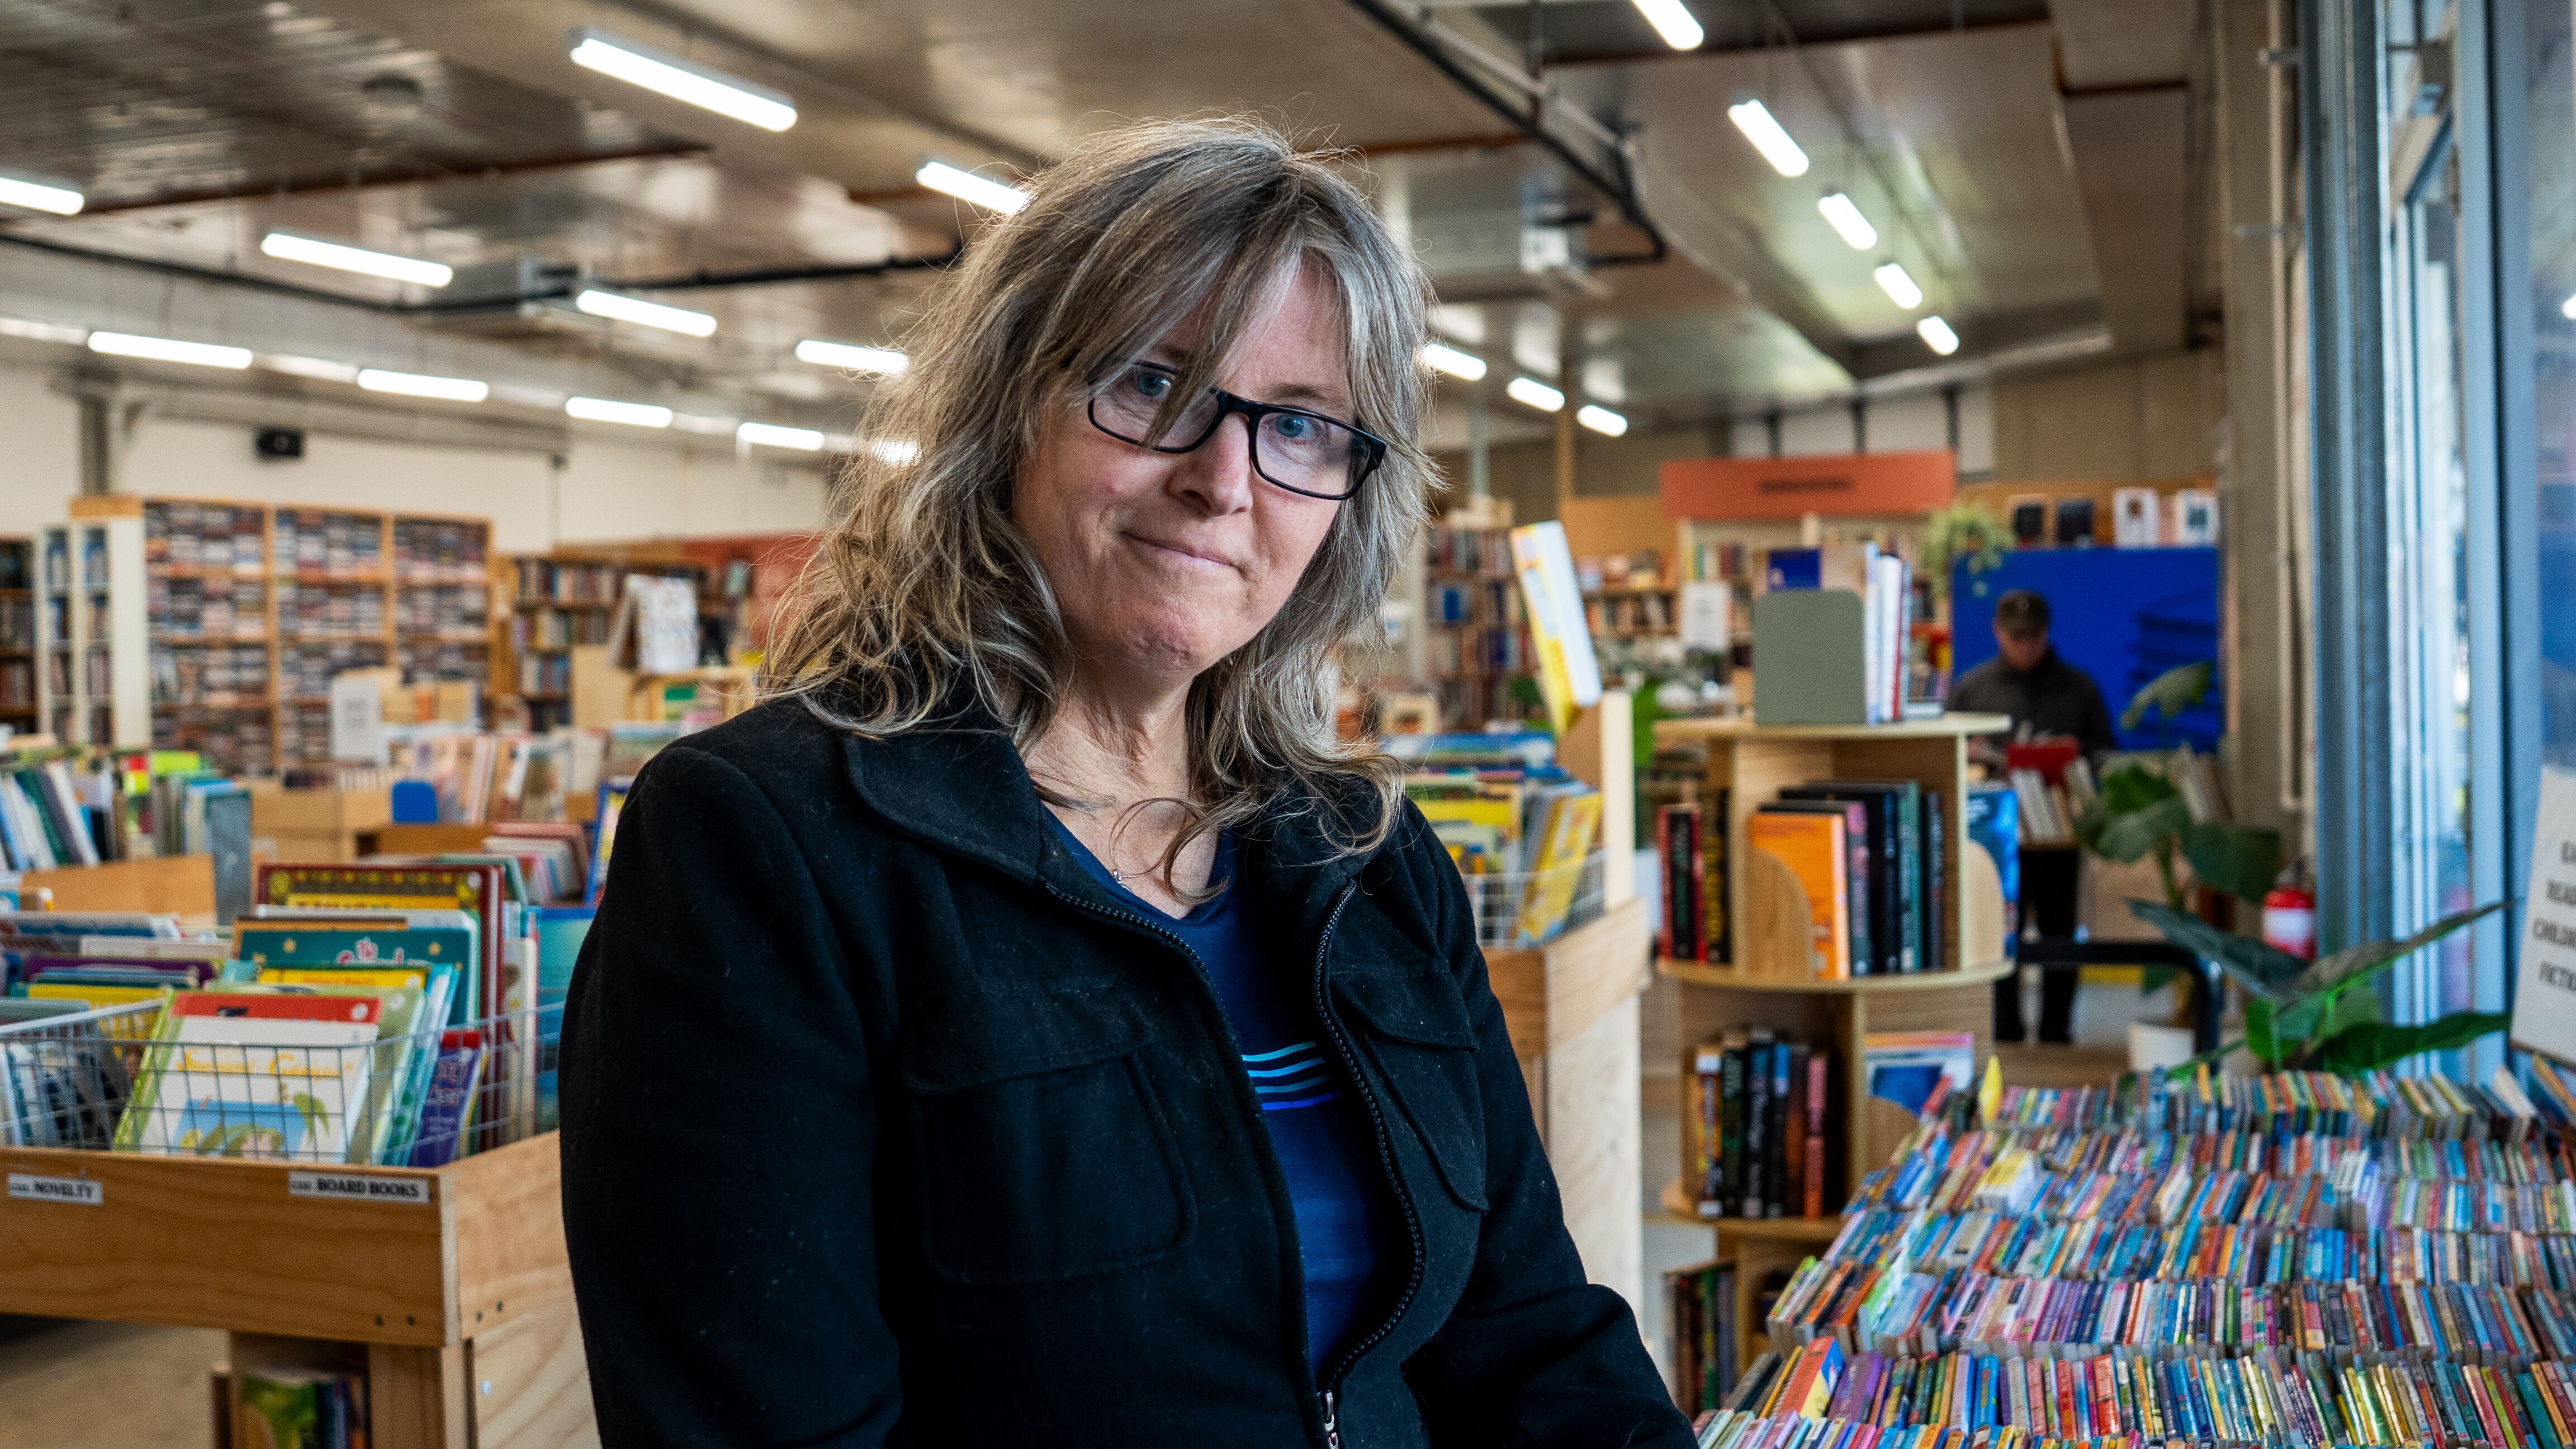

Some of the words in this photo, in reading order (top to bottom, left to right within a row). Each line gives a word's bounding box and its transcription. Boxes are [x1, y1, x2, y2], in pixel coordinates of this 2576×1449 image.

[35, 1181, 92, 1197] NOVELTY
[316, 1177, 366, 1194] BOARD
[370, 1181, 419, 1197] BOOKS
